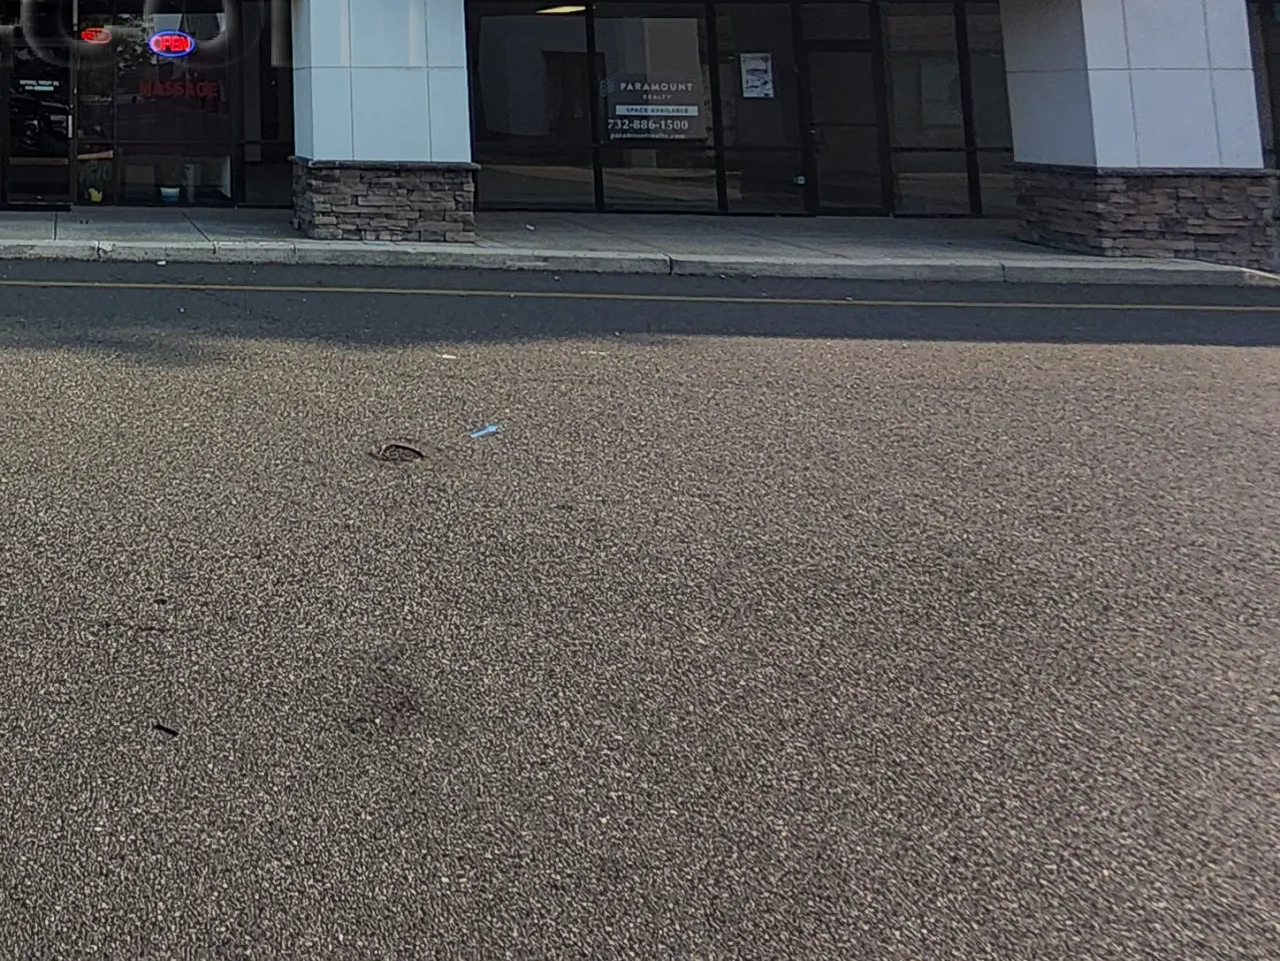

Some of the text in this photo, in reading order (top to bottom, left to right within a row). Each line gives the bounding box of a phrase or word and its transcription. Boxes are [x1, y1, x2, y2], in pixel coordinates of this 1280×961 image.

[153, 36, 190, 51] OPEN
[139, 80, 219, 98] MASSAGE
[620, 82, 694, 92] PARAMOUNT
[650, 107, 689, 115] AVAILABLE
[607, 119, 689, 131] 732-886-1500
